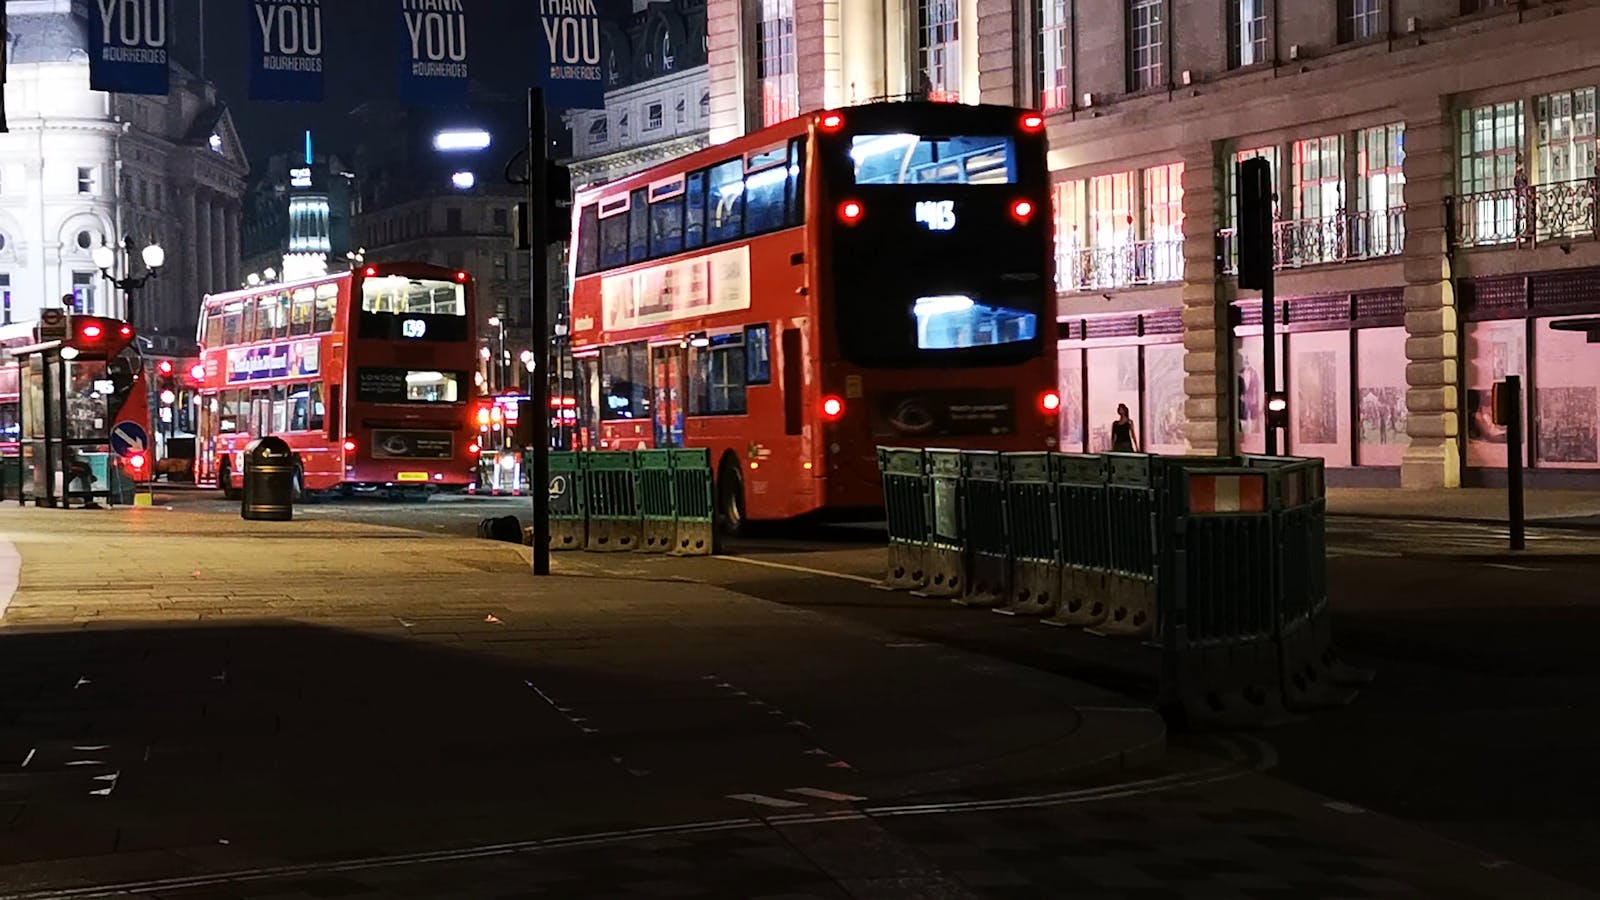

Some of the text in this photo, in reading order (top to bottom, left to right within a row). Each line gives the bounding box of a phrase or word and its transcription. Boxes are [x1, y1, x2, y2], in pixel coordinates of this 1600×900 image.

[97, 0, 165, 47] YOU
[255, 4, 321, 55] YOU
[403, 12, 466, 61] YOU
[102, 46, 166, 64] #OURHEROES
[541, 17, 600, 64] YOU
[263, 55, 322, 72] #OURHEROES
[412, 62, 467, 78] #OURHEROES
[550, 66, 601, 80] #OURHEROES
